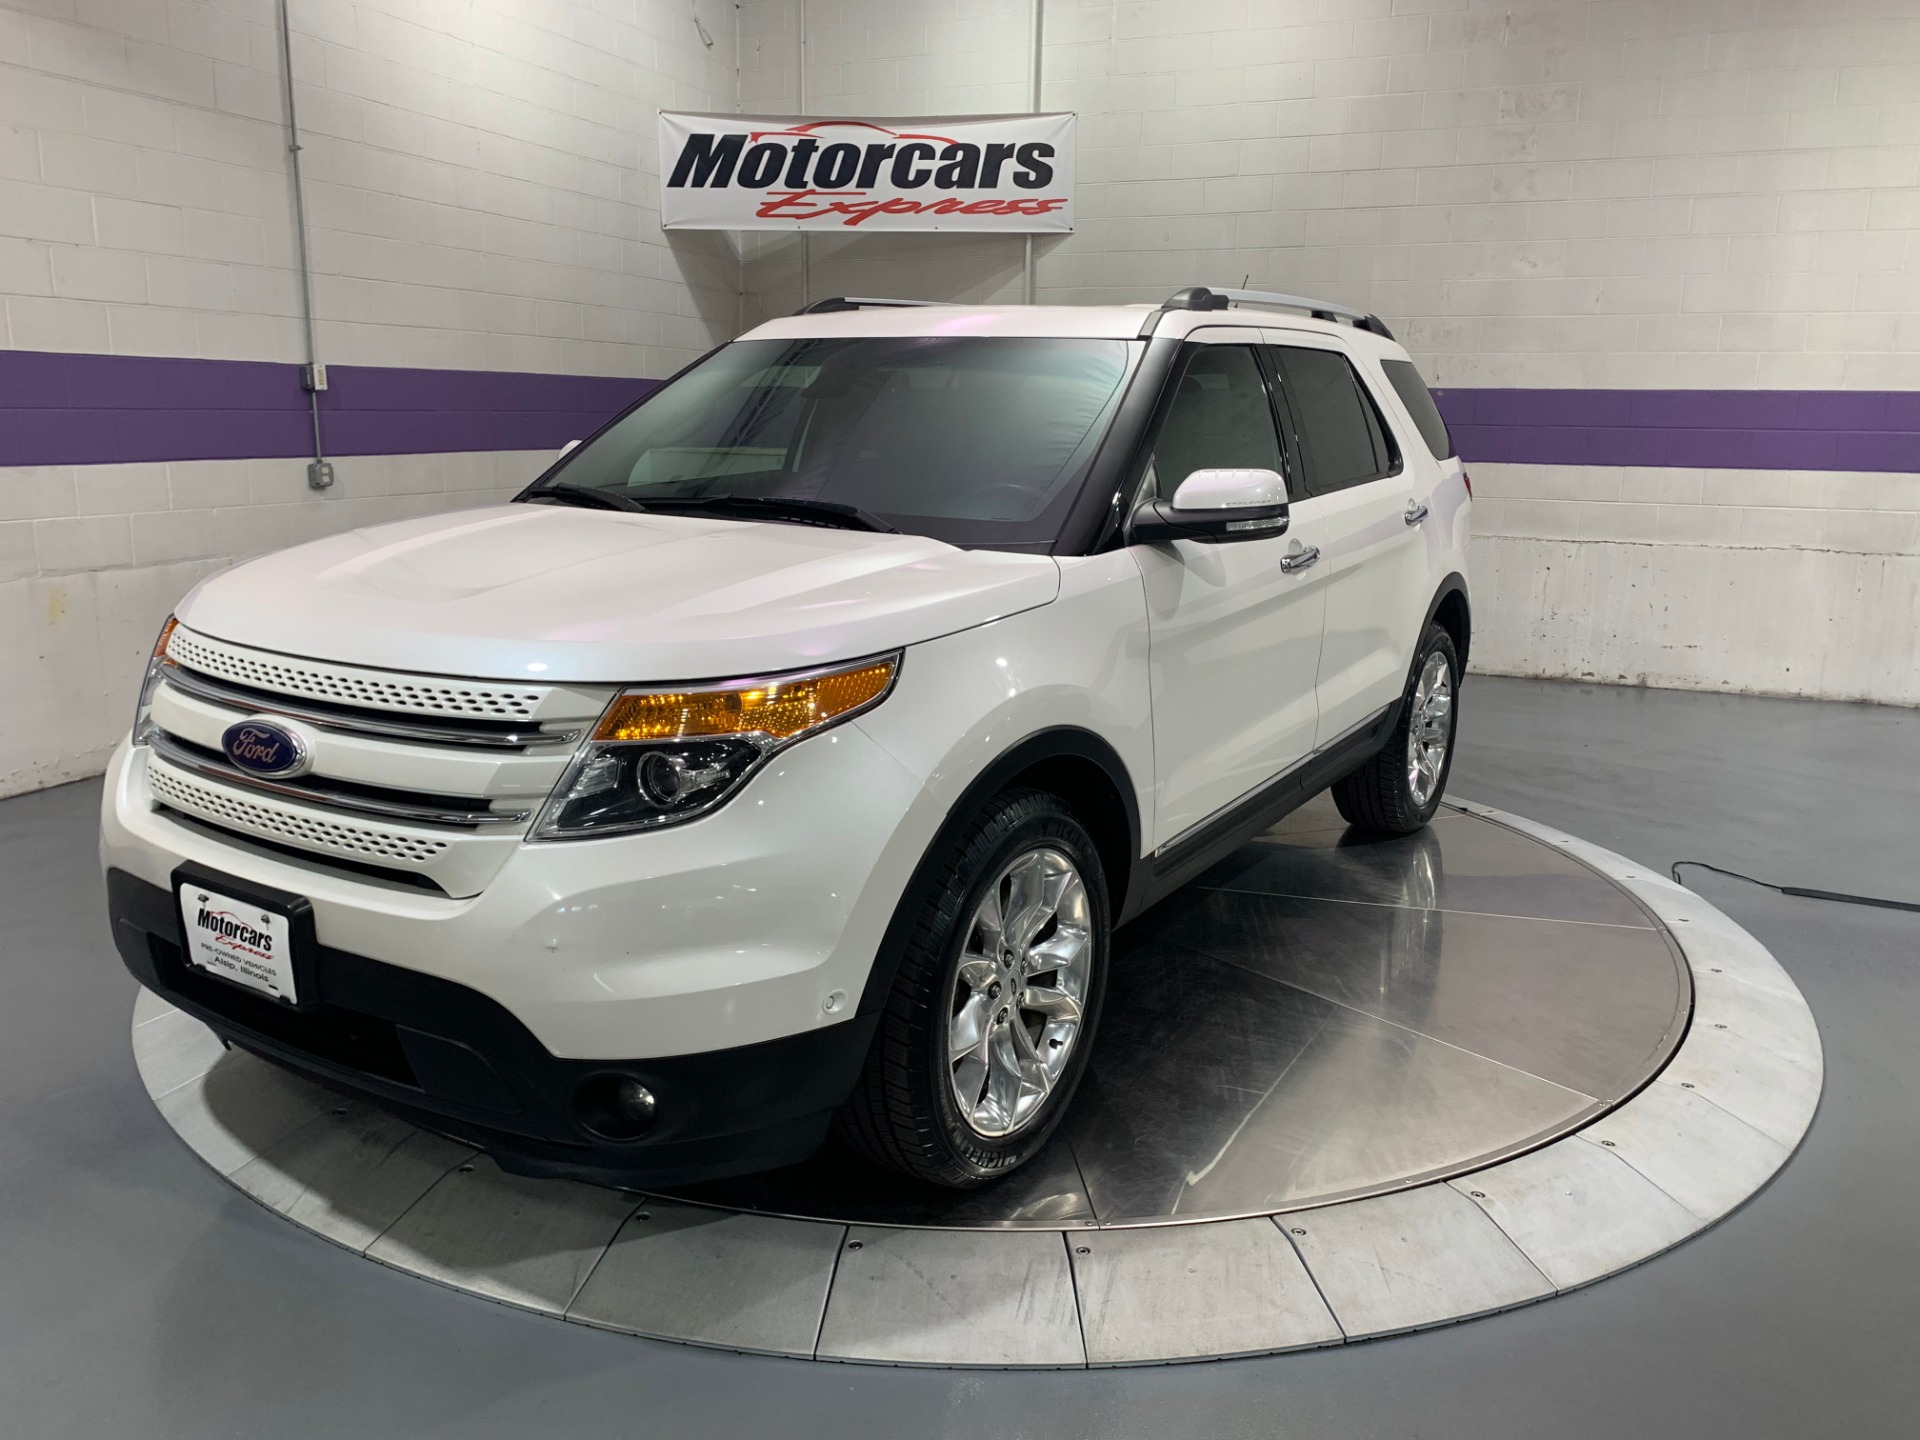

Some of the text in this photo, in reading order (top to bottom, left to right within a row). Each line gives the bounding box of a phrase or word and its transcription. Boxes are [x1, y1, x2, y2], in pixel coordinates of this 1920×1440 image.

[667, 133, 1055, 189] Motorcars
[756, 189, 1068, 226] Express
[233, 728, 279, 763] Ford
[198, 908, 272, 951] Motorcars
[215, 934, 274, 960] Express
[241, 965, 269, 982] Illinois
[243, 959, 277, 976] VEHICLES
